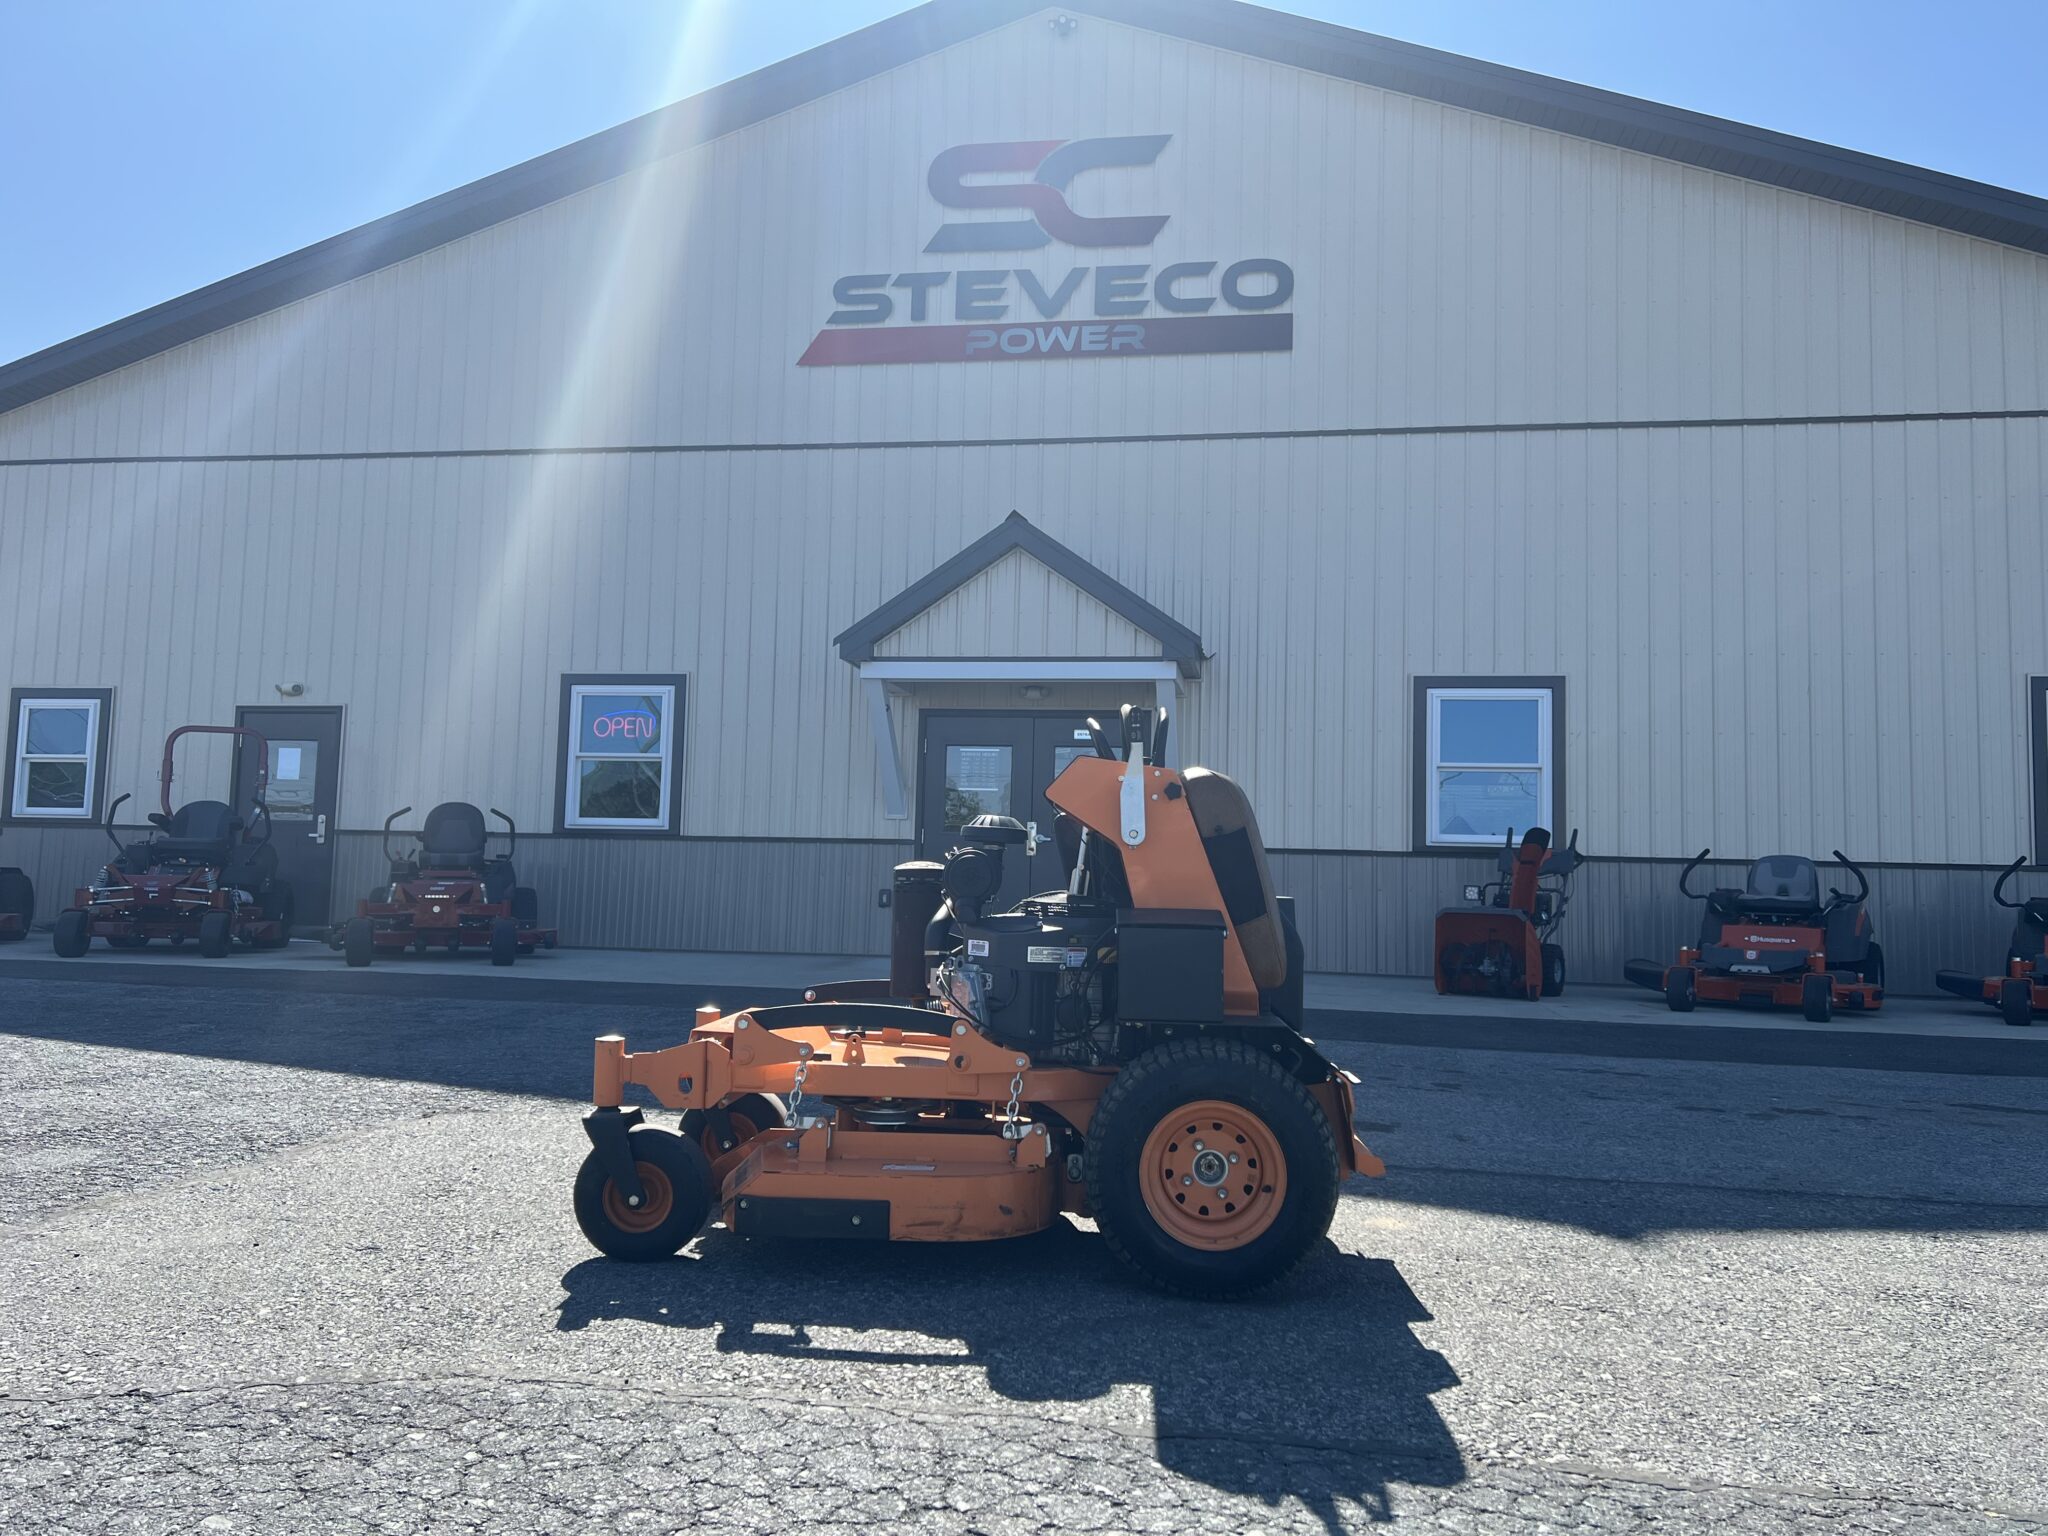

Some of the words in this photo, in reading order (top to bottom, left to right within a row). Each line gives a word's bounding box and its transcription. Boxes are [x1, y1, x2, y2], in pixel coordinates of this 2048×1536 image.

[923, 134, 1173, 253] SC
[826, 258, 1295, 325] STEVECO
[965, 324, 1146, 355] POWER
[593, 717, 653, 738] OPEN
